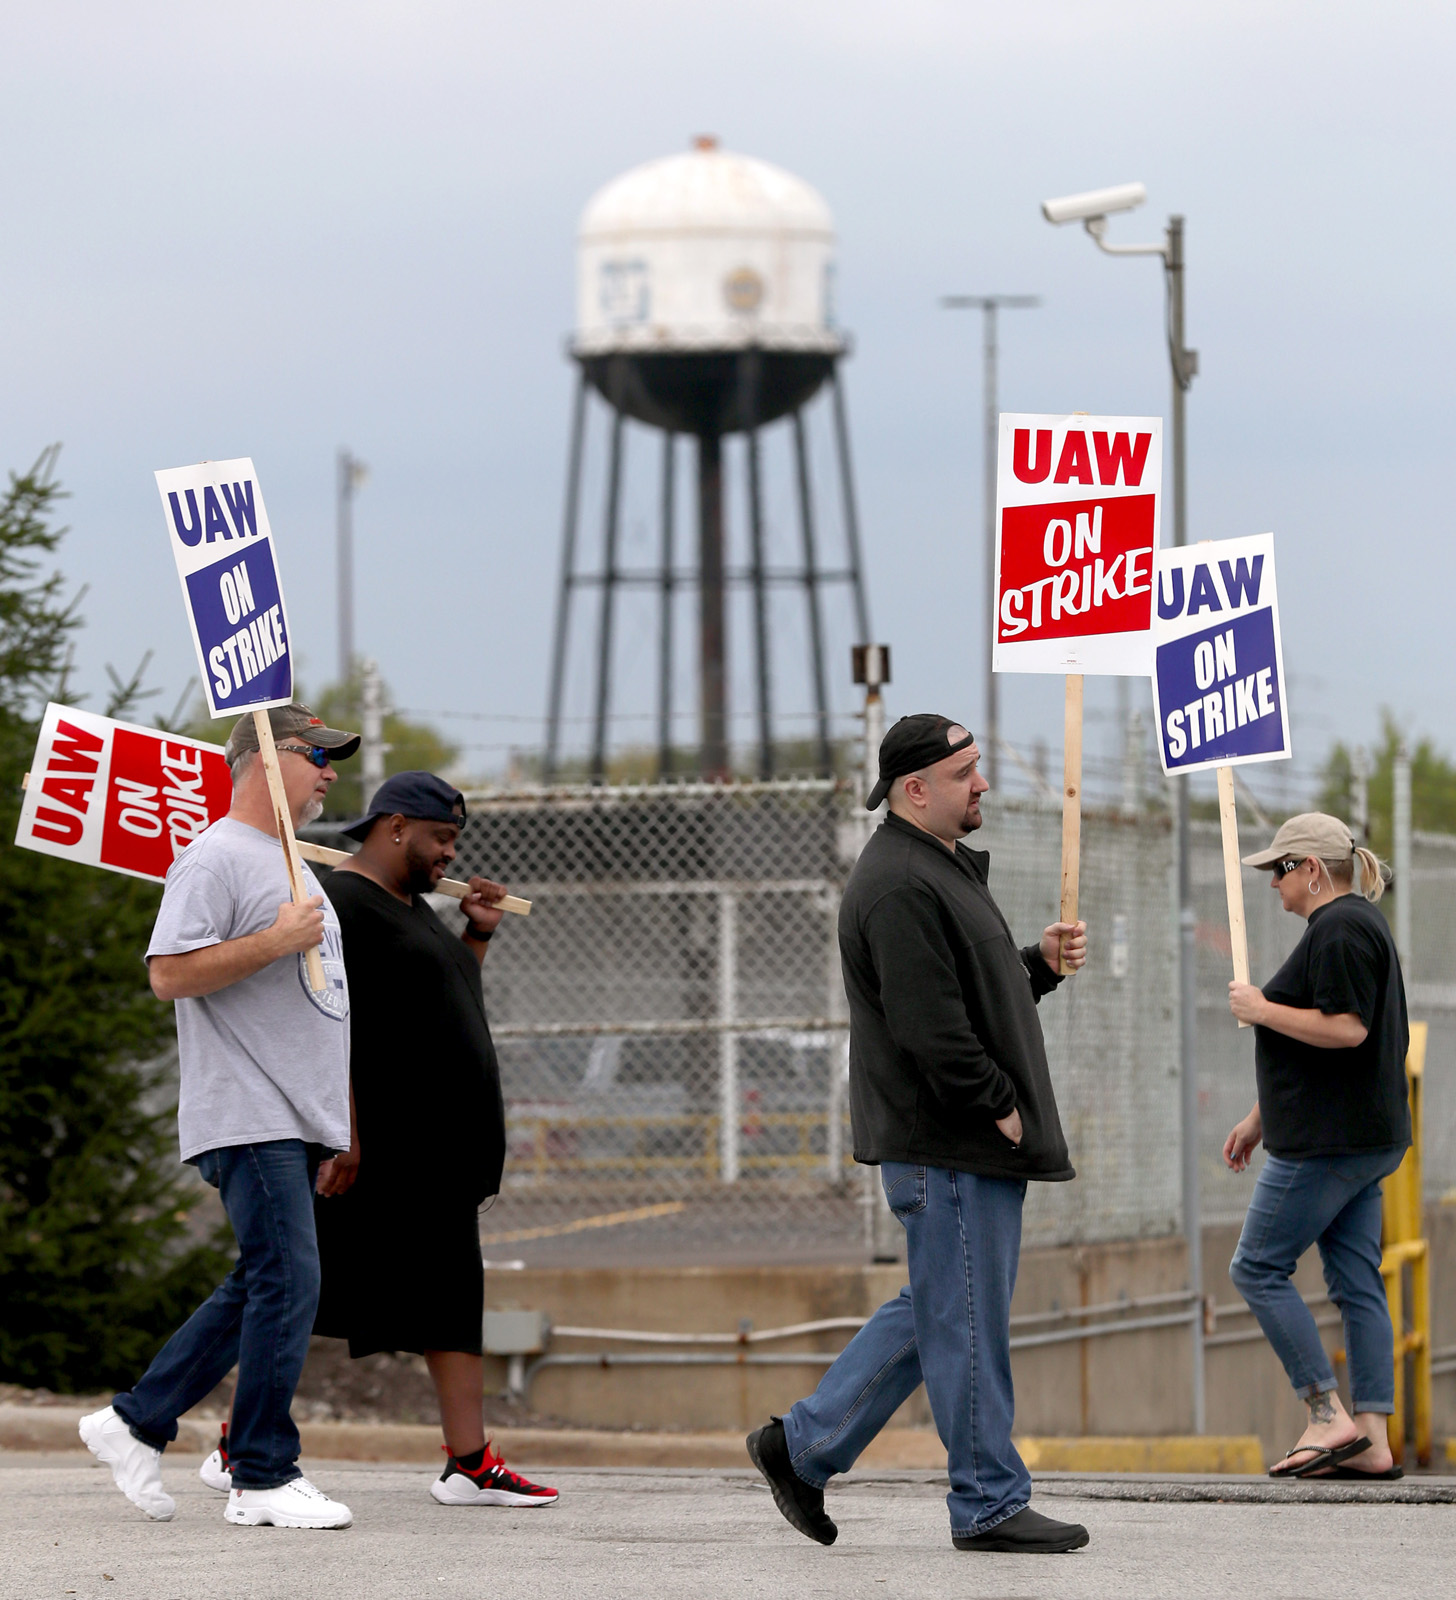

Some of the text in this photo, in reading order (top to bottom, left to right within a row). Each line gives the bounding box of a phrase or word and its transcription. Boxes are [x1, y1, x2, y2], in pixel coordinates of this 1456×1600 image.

[1013, 428, 1153, 487] UAW
[167, 479, 258, 547] UAW
[1043, 505, 1103, 567] ON
[219, 560, 256, 626] ON
[1000, 546, 1153, 637] STRIKE
[1157, 554, 1265, 620] UAW
[208, 603, 287, 700] STRIKE
[1193, 628, 1237, 691] ON
[1166, 666, 1276, 760] STRIKE
[31, 718, 105, 847] UAW
[114, 776, 163, 839] ON
[160, 740, 210, 862] TRIKE
